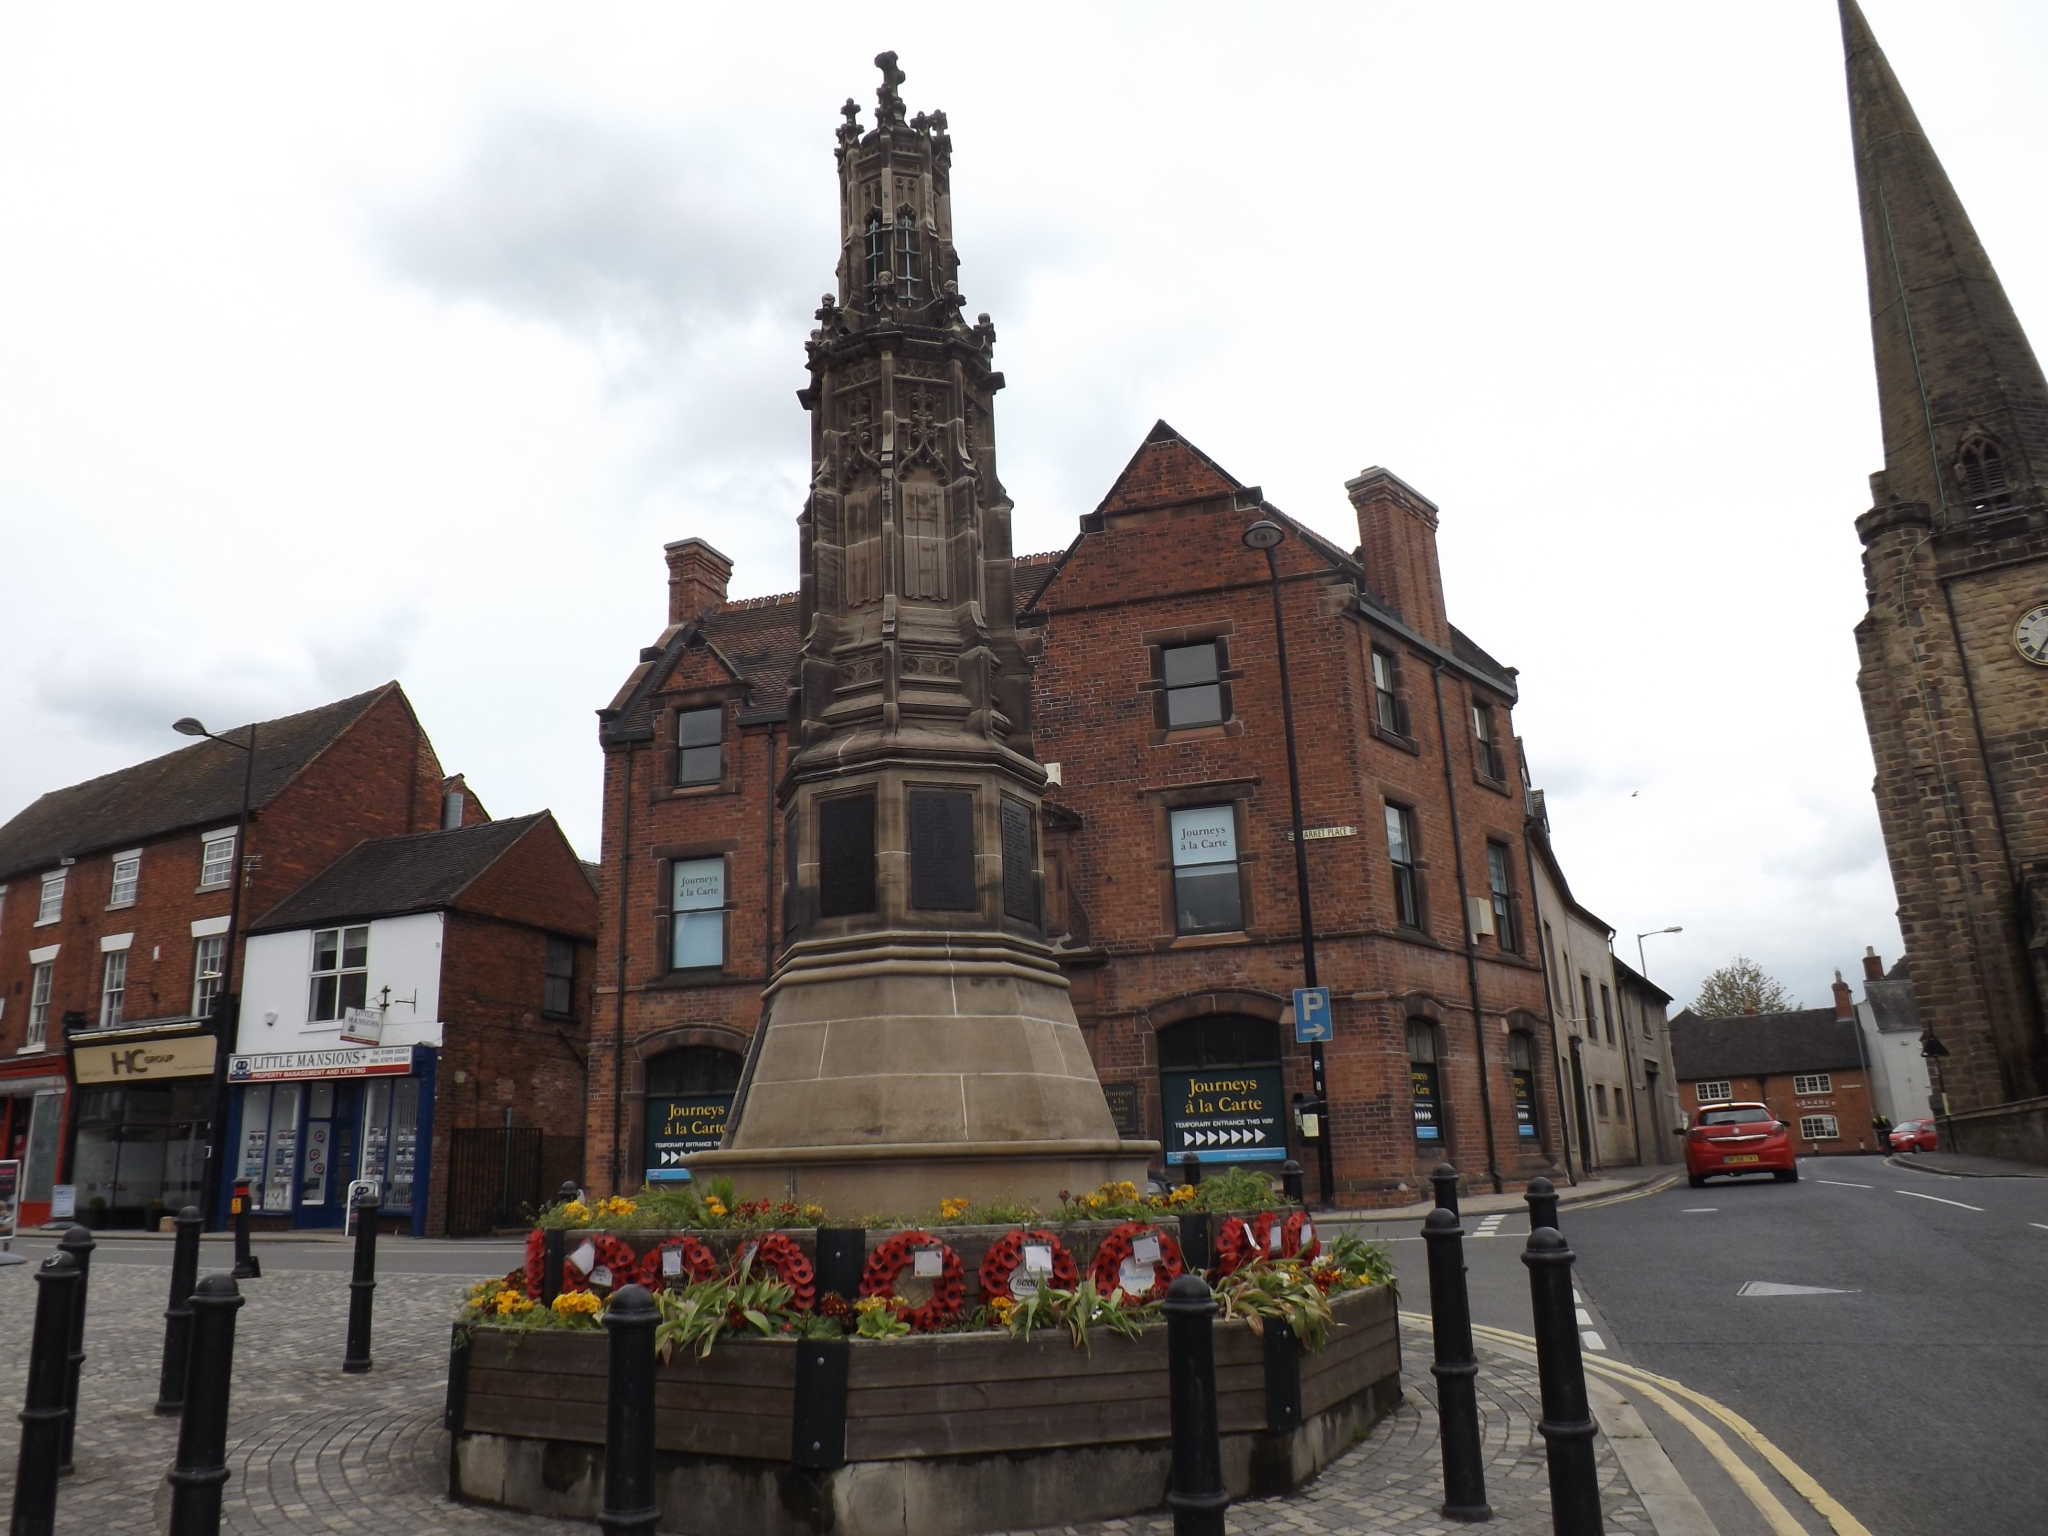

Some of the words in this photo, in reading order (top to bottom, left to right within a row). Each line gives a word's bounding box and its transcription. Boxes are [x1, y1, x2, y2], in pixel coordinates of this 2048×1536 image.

[1181, 827, 1226, 840] Journeys
[1304, 829, 1325, 838] ARKET
[1328, 828, 1347, 836] PLACE
[1180, 841, 1186, 851] à
[1189, 840, 1198, 850] la
[1201, 839, 1228, 849] Carte
[680, 875, 718, 888] Journeys
[686, 888, 694, 897] la
[696, 886, 719, 896] Carte
[1302, 992, 1323, 1021] P
[355, 1009, 375, 1019] LITTLE
[111, 1048, 148, 1075] HC
[144, 1054, 175, 1064] GROUP
[253, 1055, 294, 1069] LITTLE
[252, 1071, 283, 1079] PROPERTY
[283, 1069, 325, 1078] MANAGEMENT
[1188, 1078, 1258, 1098] Journeys
[1185, 1099, 1195, 1114] à
[1199, 1098, 1214, 1113] la
[1218, 1096, 1263, 1112] Carte
[668, 1103, 725, 1121] Journeys
[664, 1122, 672, 1135] à
[675, 1121, 688, 1135] la
[1175, 1121, 1211, 1129] TEMPORARY
[1212, 1119, 1245, 1127] ENTRANCE
